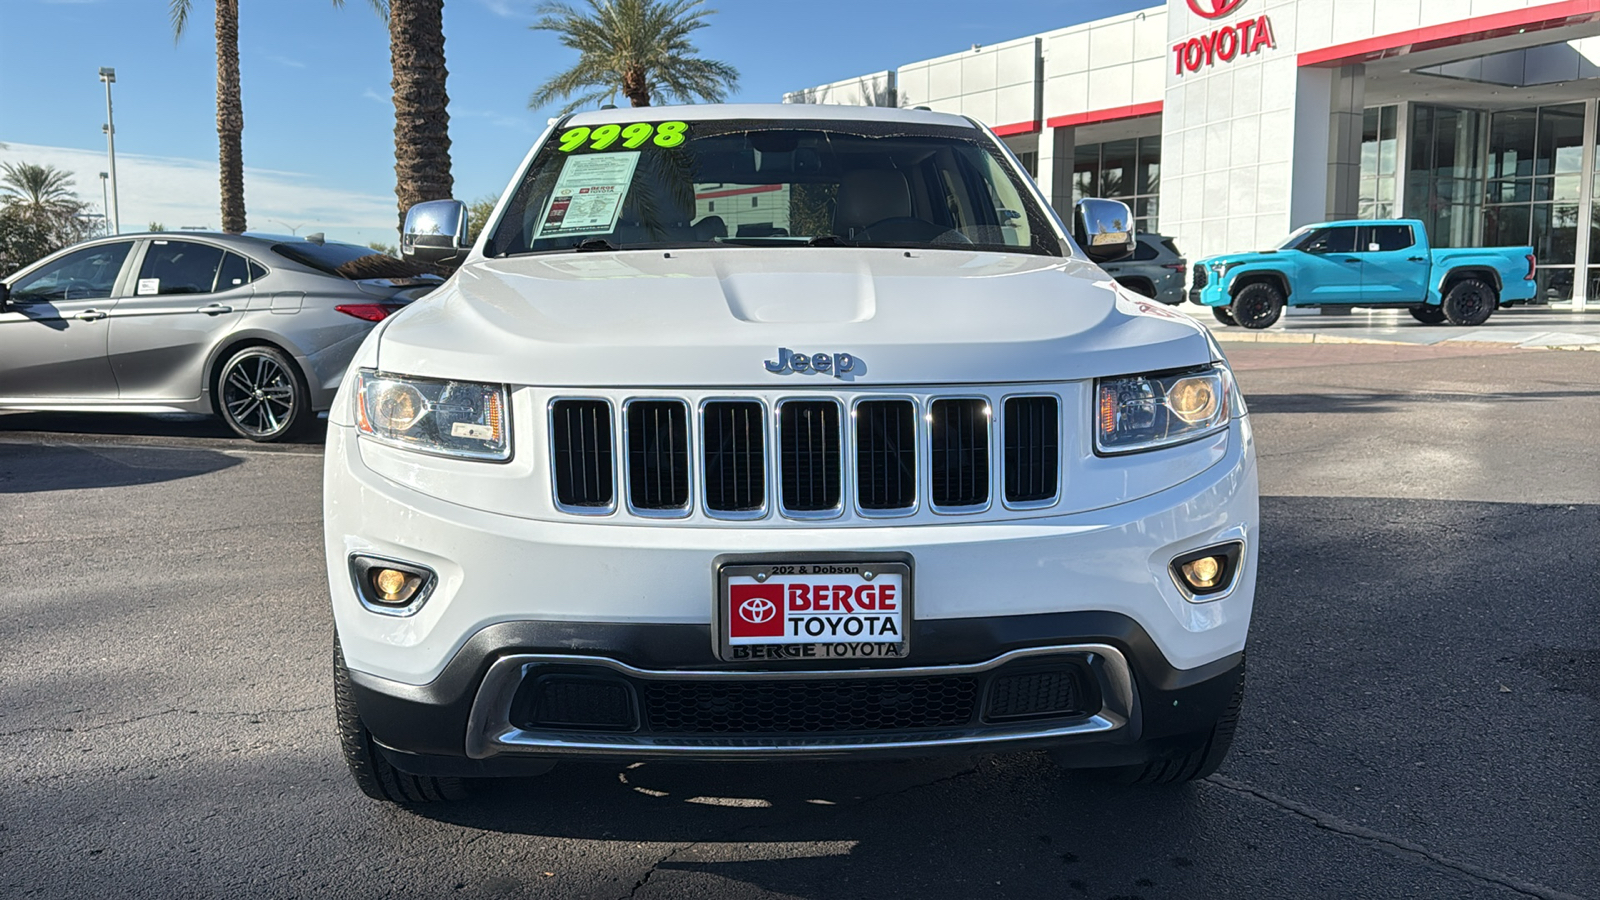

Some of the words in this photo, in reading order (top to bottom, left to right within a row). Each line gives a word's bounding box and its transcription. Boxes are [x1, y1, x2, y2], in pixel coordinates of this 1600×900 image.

[1172, 15, 1275, 75] TOYOTA
[558, 121, 689, 152] 9998
[763, 347, 854, 378] Jeep
[772, 566, 795, 575] 202
[798, 566, 808, 574] &
[812, 565, 859, 574] Dobson
[788, 583, 897, 613] BERGE
[788, 616, 898, 636] TOYOTA
[733, 644, 816, 659] BERGE
[824, 642, 899, 657] TOYOTA
